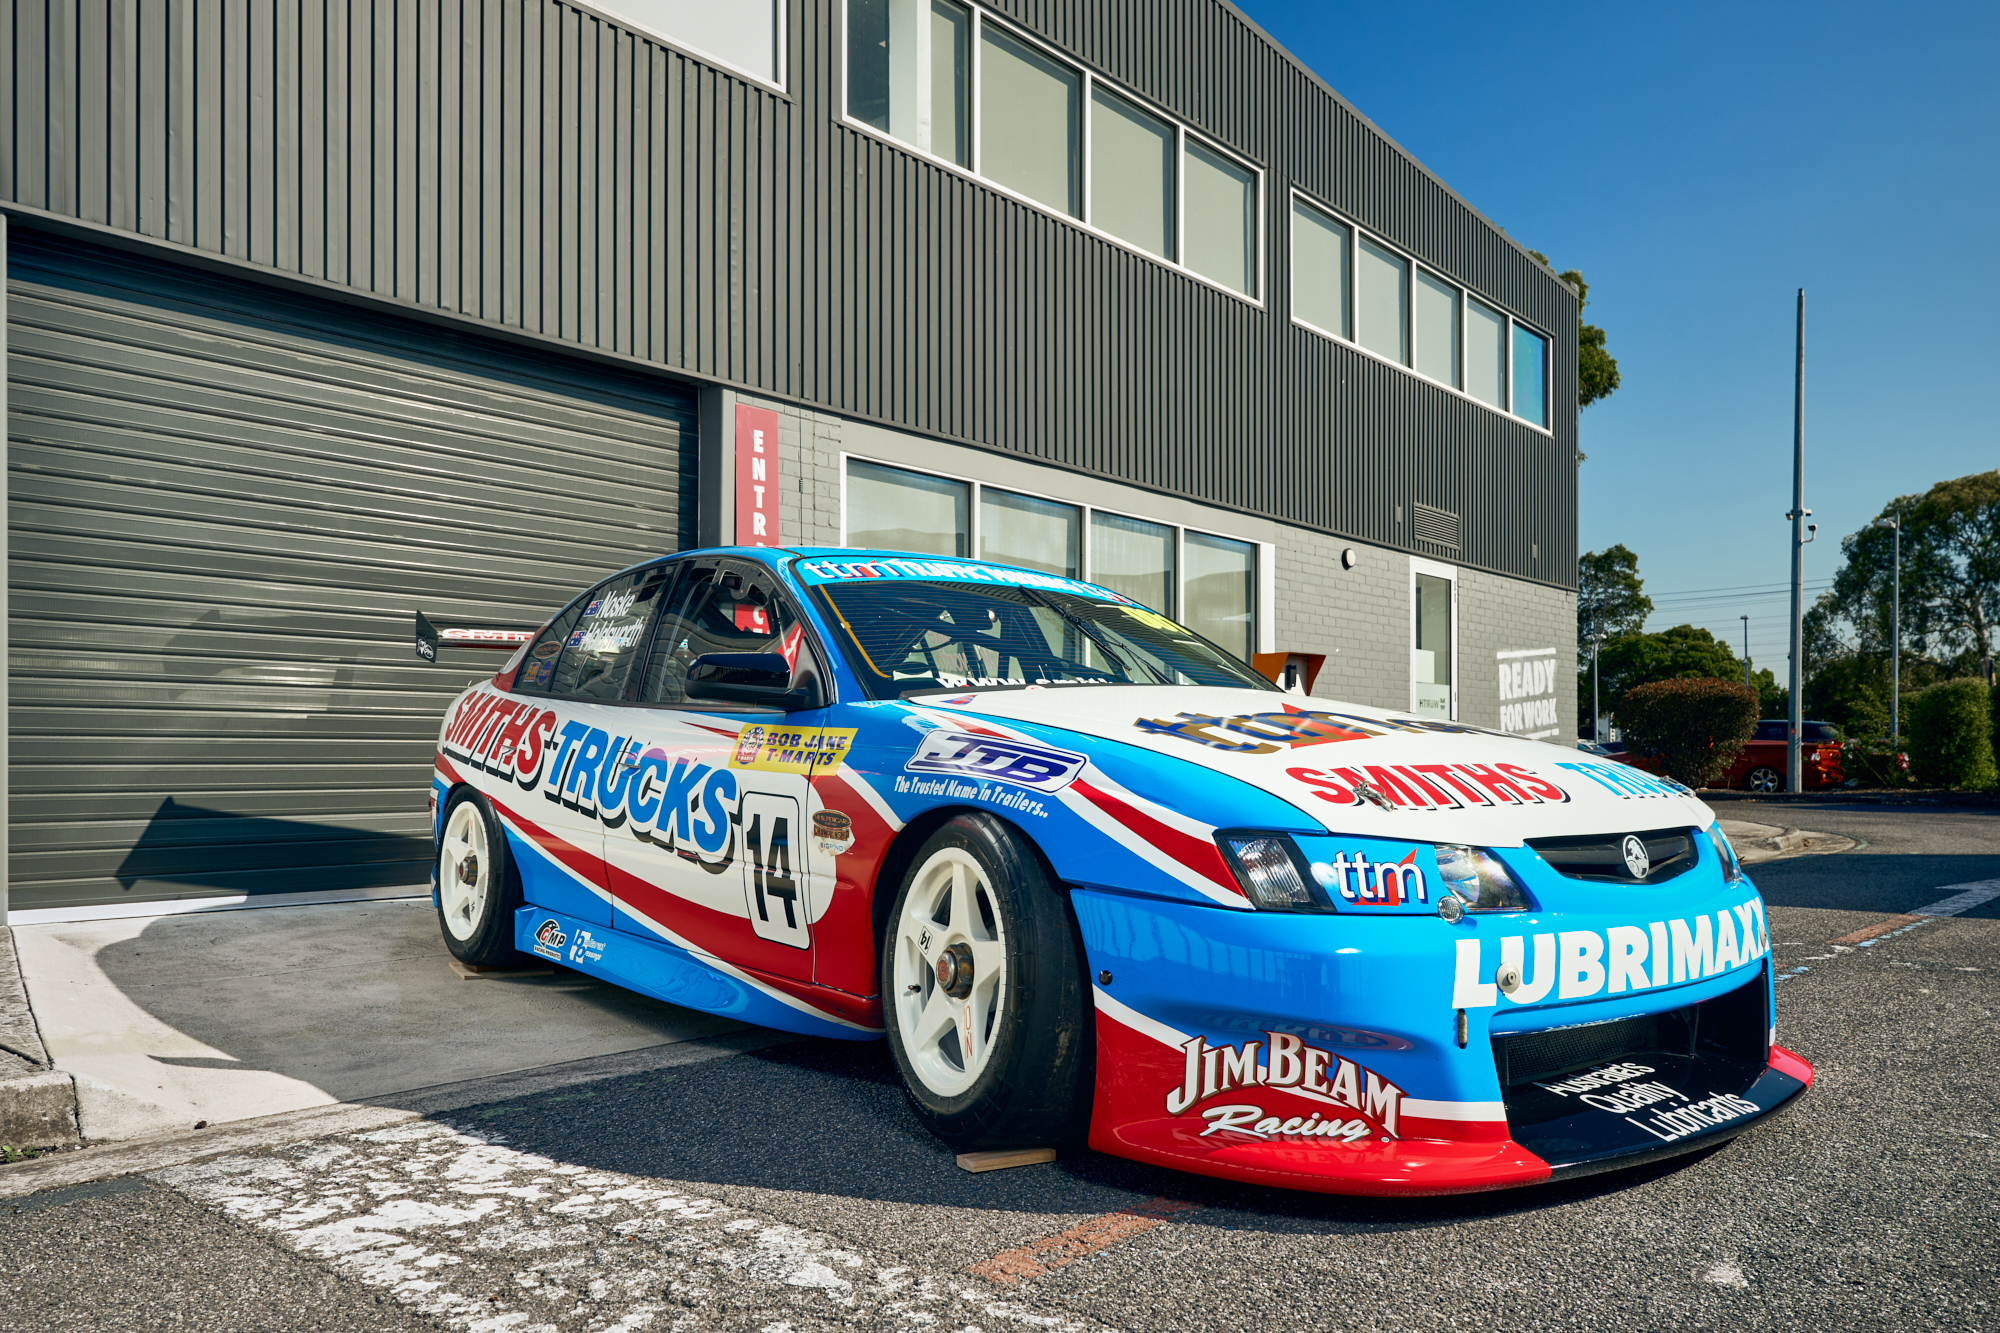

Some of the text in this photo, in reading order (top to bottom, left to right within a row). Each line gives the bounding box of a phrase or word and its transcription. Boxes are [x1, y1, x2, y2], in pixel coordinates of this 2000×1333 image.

[752, 429, 767, 547] ENTR
[802, 560, 903, 579] ttm
[886, 559, 993, 580] TRAFFIC
[595, 588, 636, 618] Noske
[579, 616, 644, 651] Holdsworth
[1498, 659, 1556, 700] READY
[1500, 703, 1523, 732] FOR
[1523, 698, 1558, 729] WORK
[766, 732, 848, 750] BOB JANE
[911, 735, 1081, 783] JTB
[444, 690, 738, 862] SMITHS TRUCKS
[894, 776, 910, 793] The
[910, 777, 944, 796] Trusted
[946, 779, 978, 799] Name
[978, 783, 989, 802] in
[1286, 763, 1568, 808] SMITHS
[746, 813, 798, 929] 14
[1332, 850, 1427, 902] ttm
[919, 929, 931, 950] 14
[1452, 897, 1770, 1009] LUBRIMAXX
[1166, 1030, 1405, 1138] JIM BEAM
[1579, 1081, 1690, 1114] Quality
[1199, 1105, 1372, 1143] Racing
[1624, 1091, 1761, 1142] Lubricants
